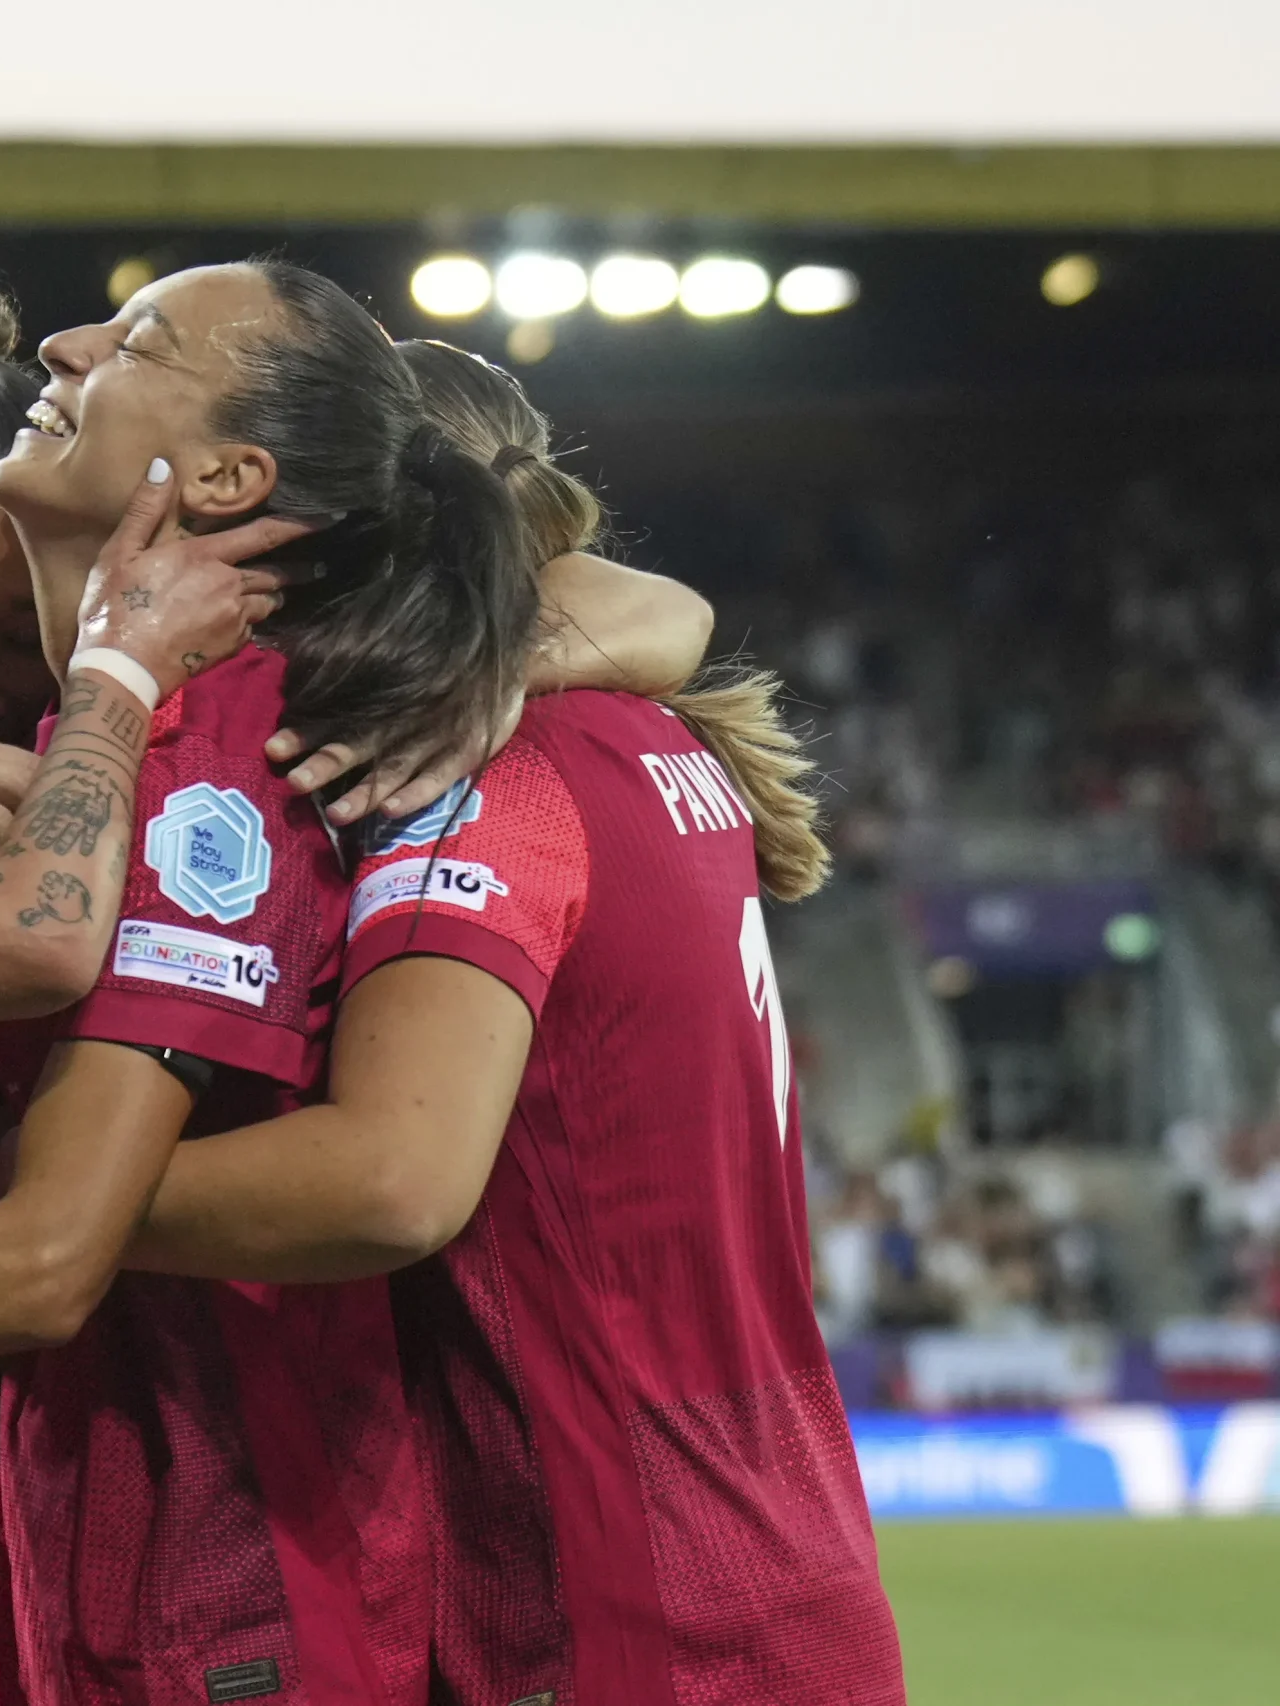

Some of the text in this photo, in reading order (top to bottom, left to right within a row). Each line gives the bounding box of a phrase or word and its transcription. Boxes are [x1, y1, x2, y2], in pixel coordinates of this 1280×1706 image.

[192, 825, 213, 842] We
[191, 840, 222, 862] Play
[190, 854, 236, 882] Strong
[437, 868, 481, 894] 10
[122, 925, 151, 937] UEFA
[120, 941, 265, 988] FOUNDATION 10
